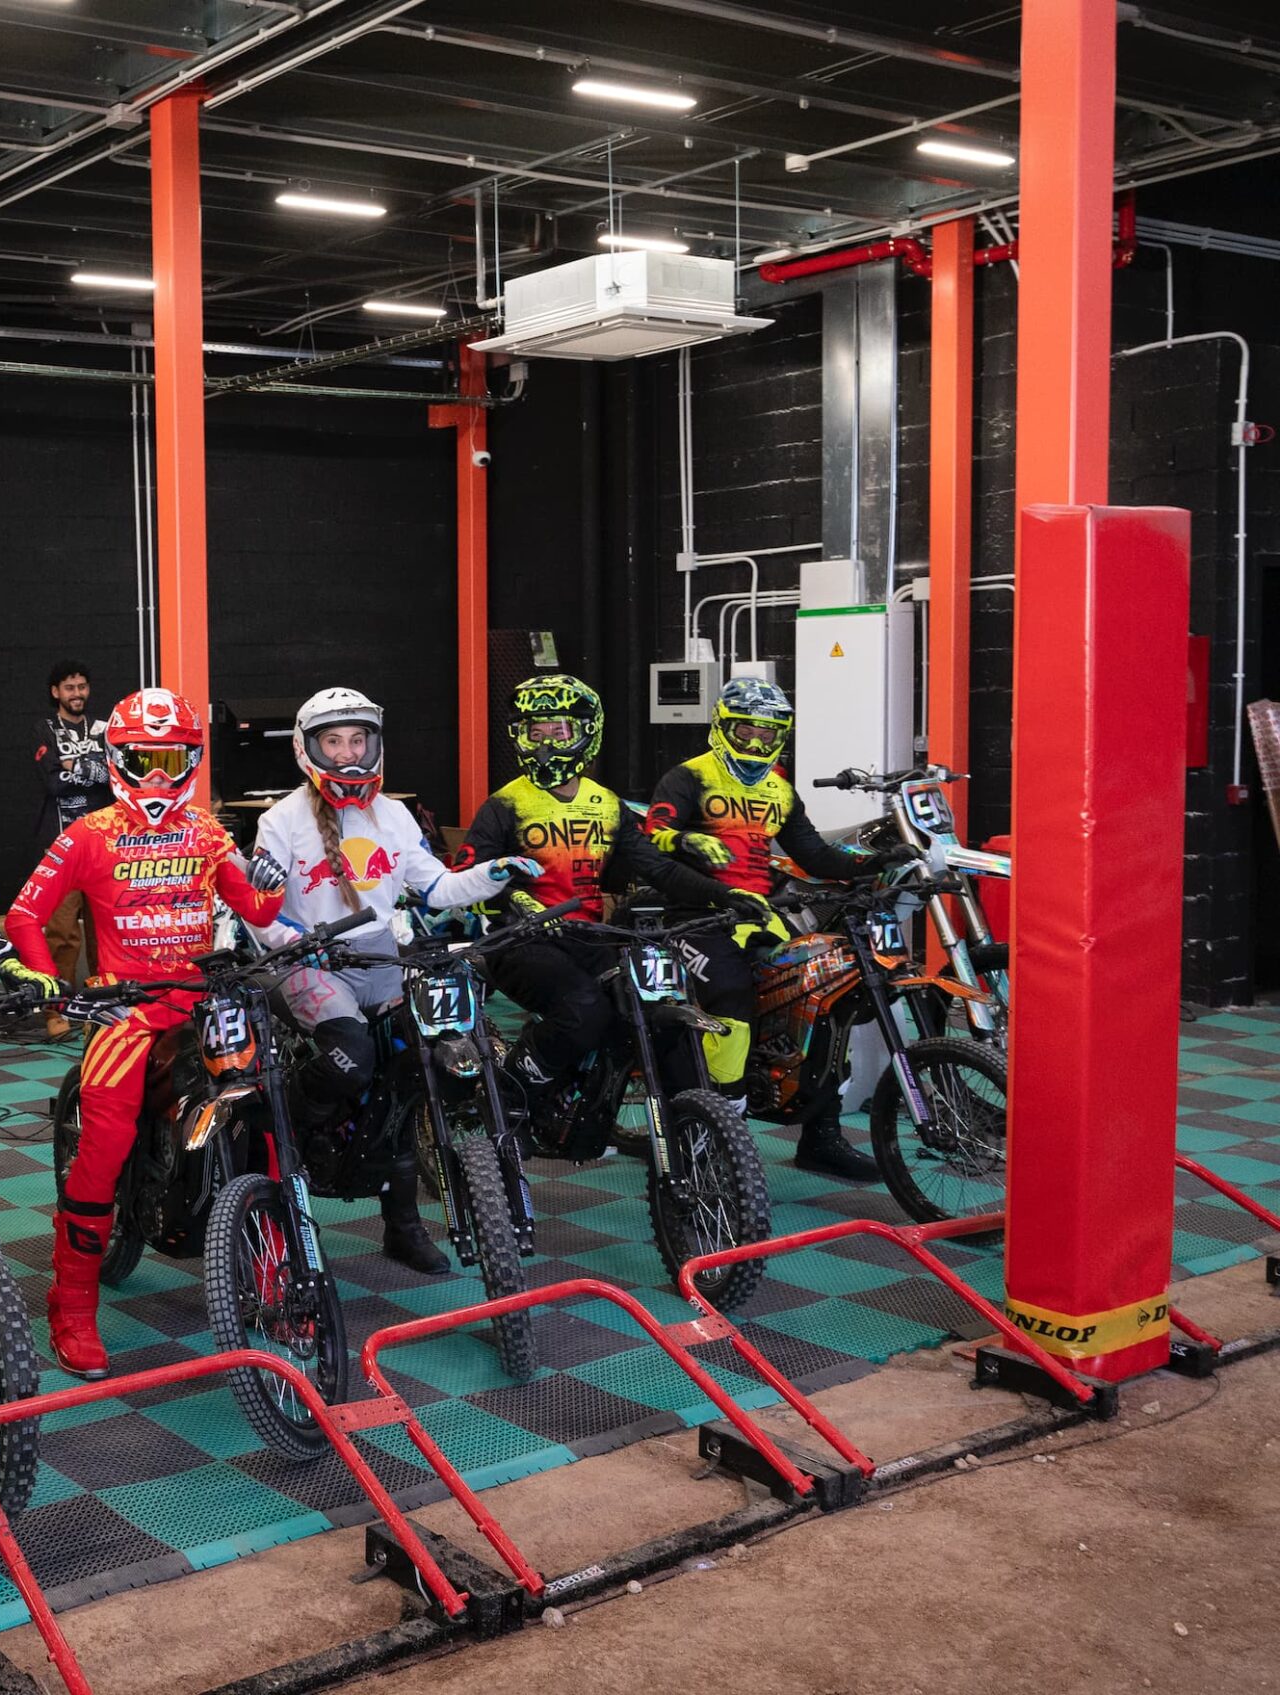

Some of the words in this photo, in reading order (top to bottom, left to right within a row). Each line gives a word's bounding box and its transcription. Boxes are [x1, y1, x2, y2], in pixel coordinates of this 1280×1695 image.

[115, 829, 185, 848] Andreani
[113, 857, 206, 881] CIRCUIT
[130, 876, 193, 889] EQUIPMENT
[113, 913, 172, 930] TEAM
[175, 911, 209, 926] JCR
[328, 1046, 359, 1074] FOX
